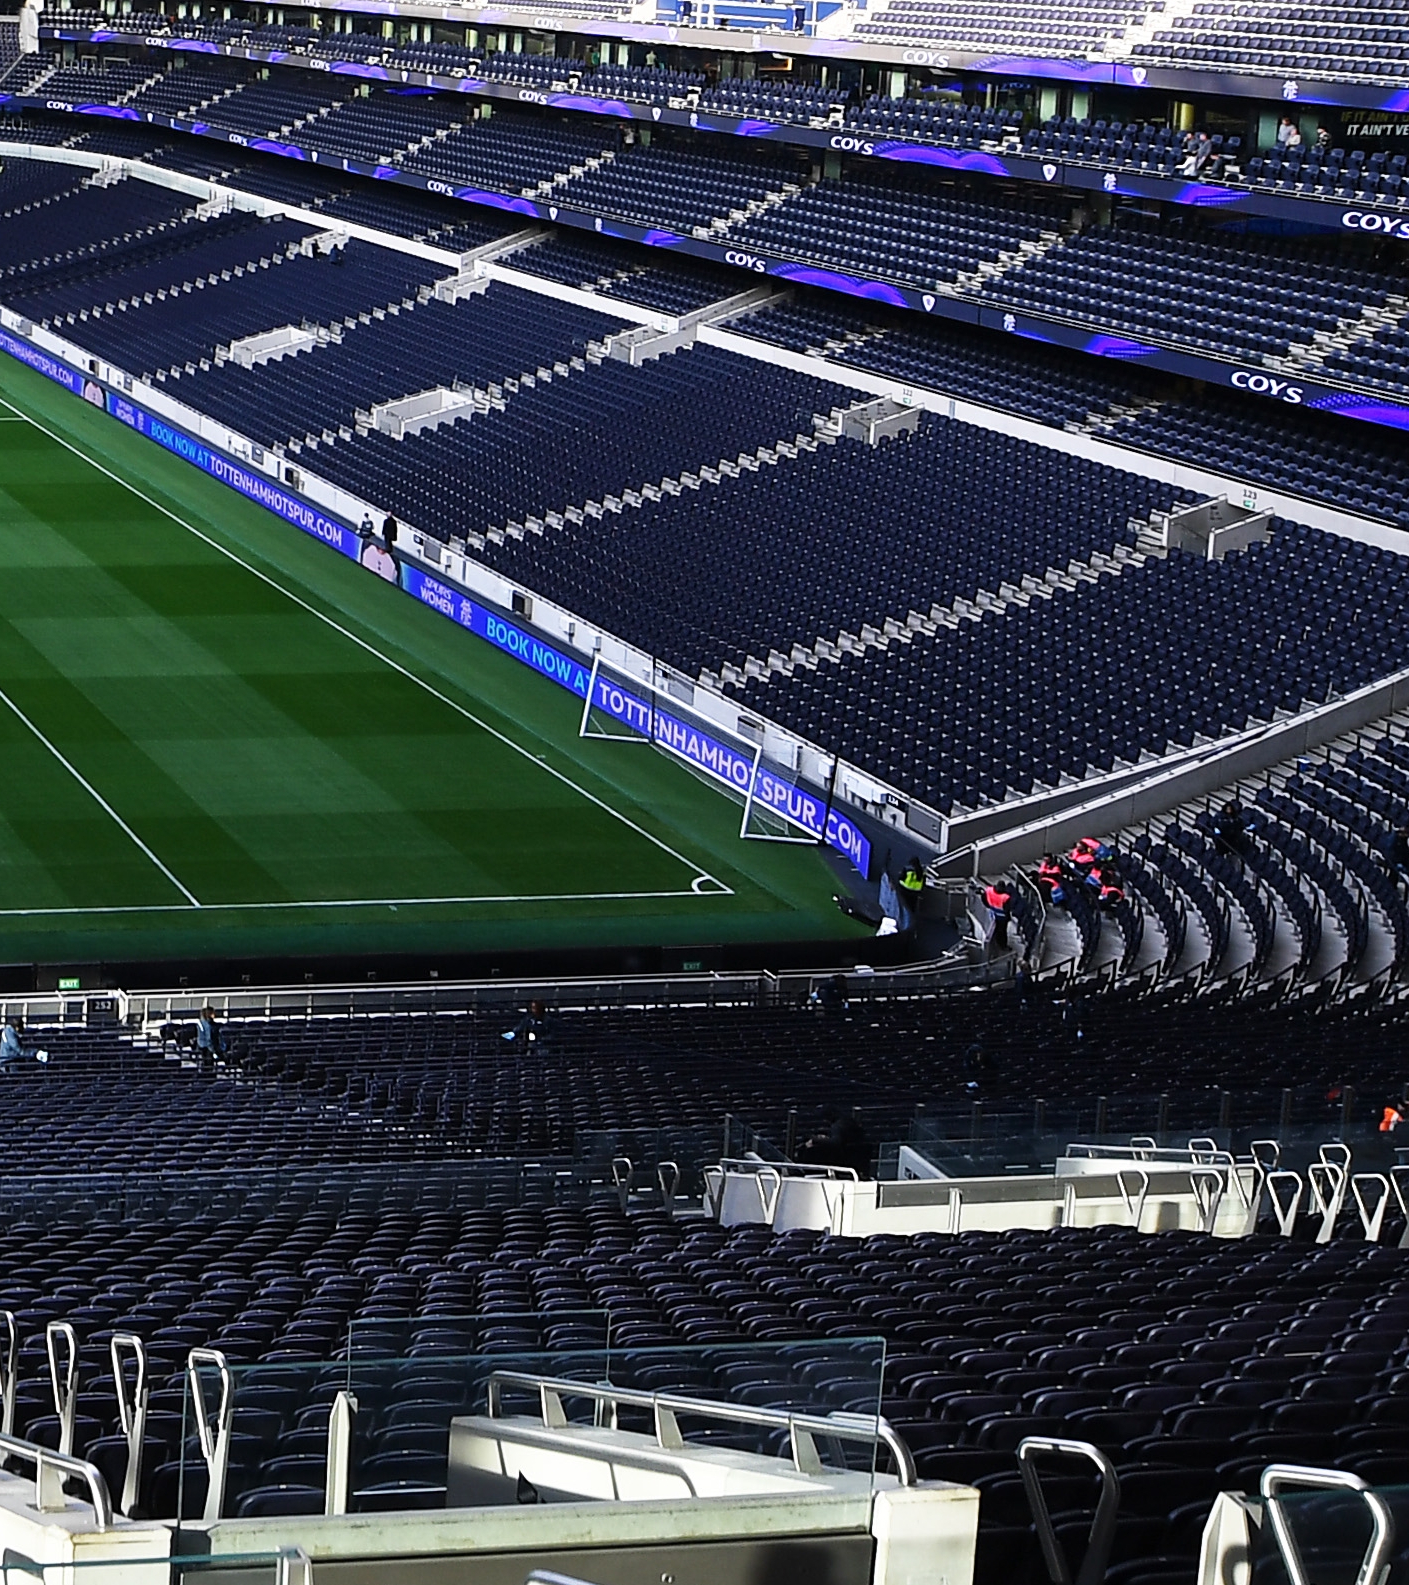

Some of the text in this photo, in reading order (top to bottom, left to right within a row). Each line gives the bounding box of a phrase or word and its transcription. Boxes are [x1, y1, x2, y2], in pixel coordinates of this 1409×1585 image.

[902, 50, 950, 68] COYS
[1347, 124, 1360, 136] IT
[1360, 124, 1394, 136] AIN'T
[831, 136, 874, 155] COYS
[1342, 211, 1409, 239] COYS
[725, 251, 766, 273] COYS
[1231, 371, 1303, 403] COYS
[151, 421, 343, 547] BOOK NOW AT TOTTENHAMHOTSPUR.COM
[1243, 489, 1257, 500] 123
[419, 585, 455, 617] WOMEN
[486, 616, 530, 660] BOOK
[532, 643, 572, 683] NOW
[683, 962, 701, 970] EXIT
[94, 1001, 112, 1010] 252
